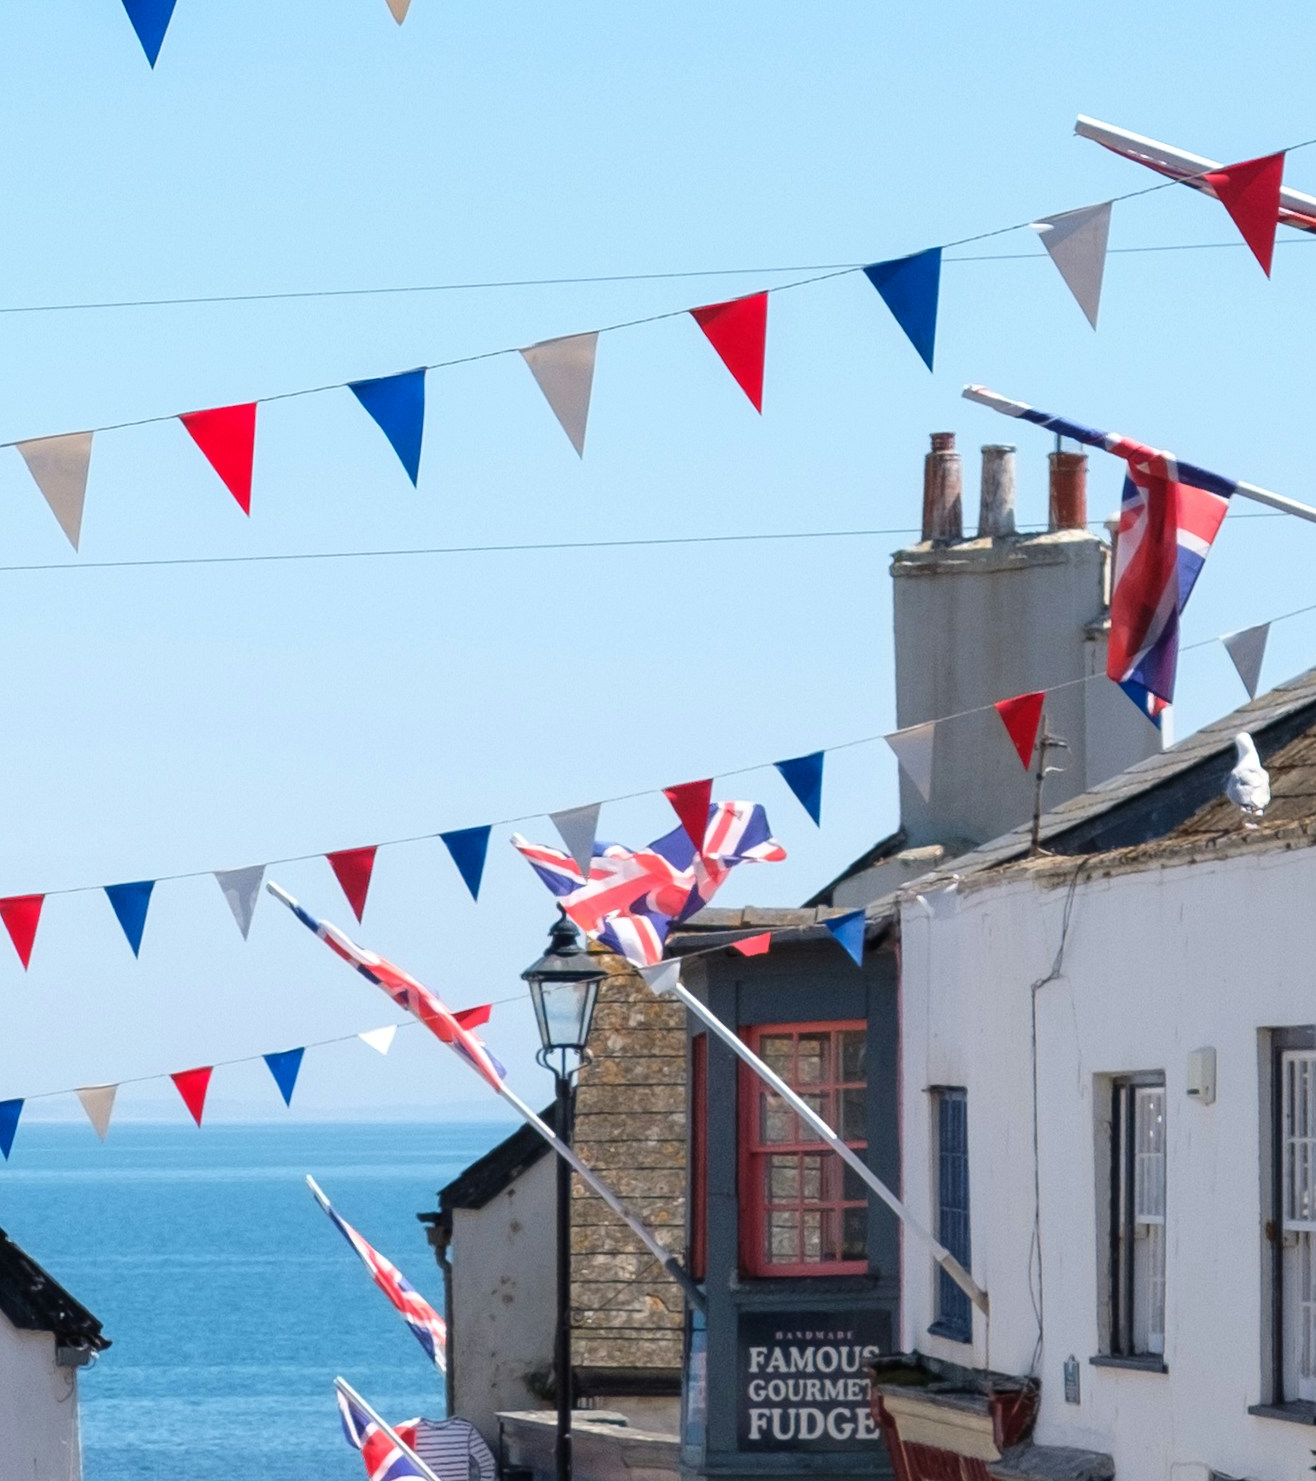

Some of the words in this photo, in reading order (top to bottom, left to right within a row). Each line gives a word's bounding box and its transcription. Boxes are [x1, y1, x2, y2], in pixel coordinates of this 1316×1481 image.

[775, 1331, 854, 1340] HANDMADE
[748, 1345, 880, 1373] FAMOUS
[748, 1378, 872, 1401] GOURMET
[748, 1407, 880, 1440] FUDGE
